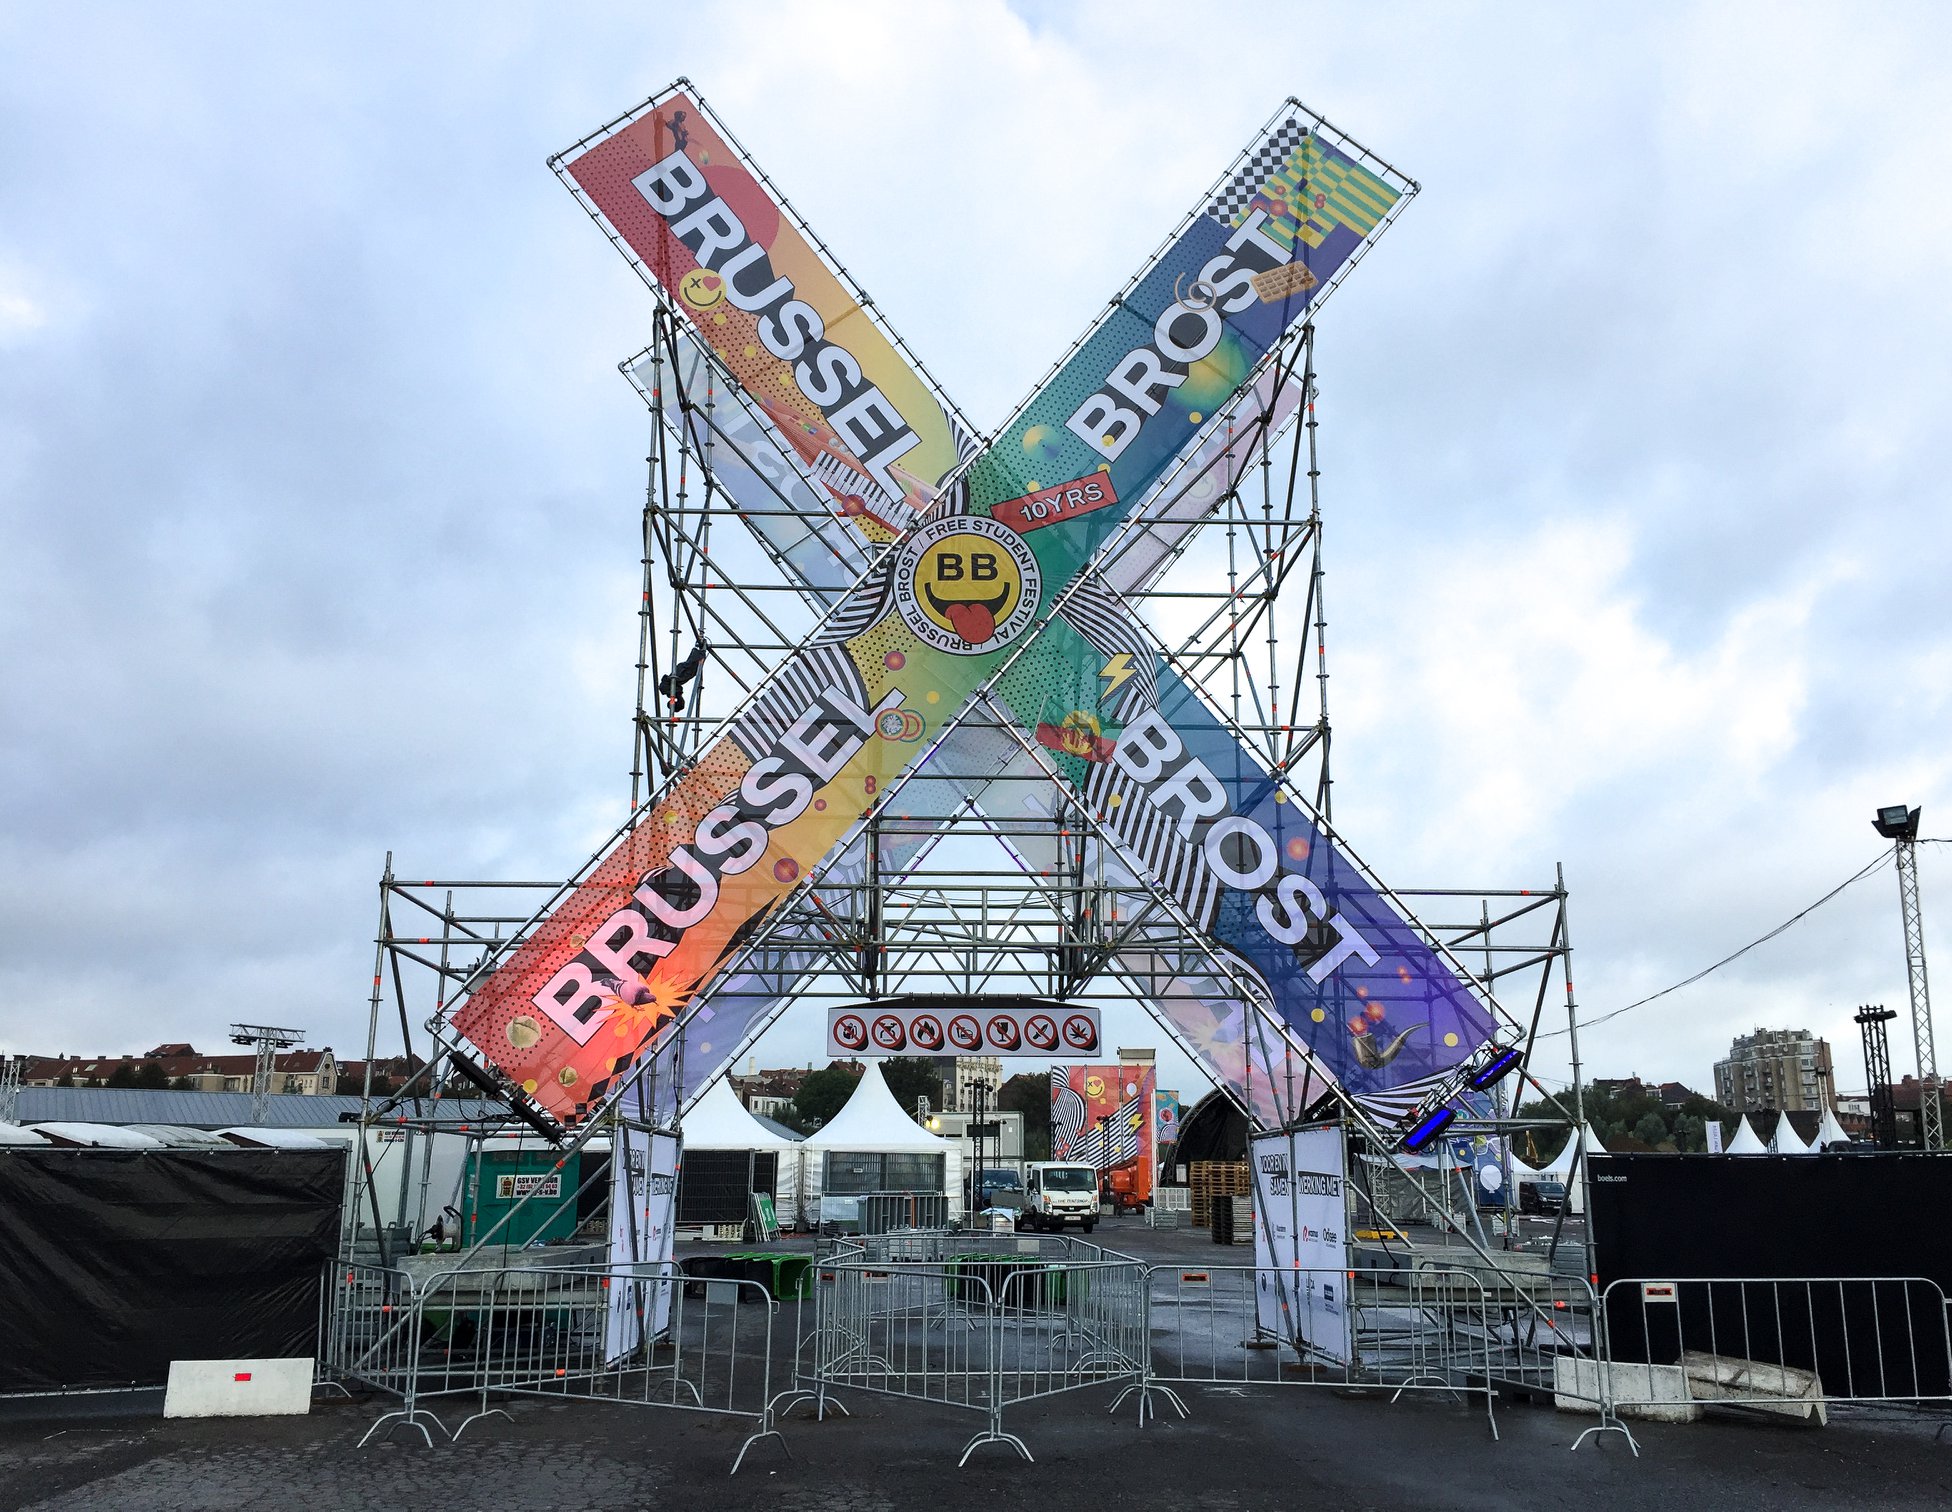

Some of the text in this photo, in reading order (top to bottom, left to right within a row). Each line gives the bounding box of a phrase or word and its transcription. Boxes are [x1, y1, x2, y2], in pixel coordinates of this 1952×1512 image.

[631, 149, 922, 505] BRUSSEL
[1065, 206, 1293, 463] BROST
[898, 518, 1037, 651] BRUSSEL BROST FREE STUDENT FESTIVAL
[1020, 481, 1104, 522] 10YRS
[533, 685, 907, 1047] BRUSSEL
[1113, 705, 1382, 985] BROST
[1597, 1174, 1627, 1182] boels.com
